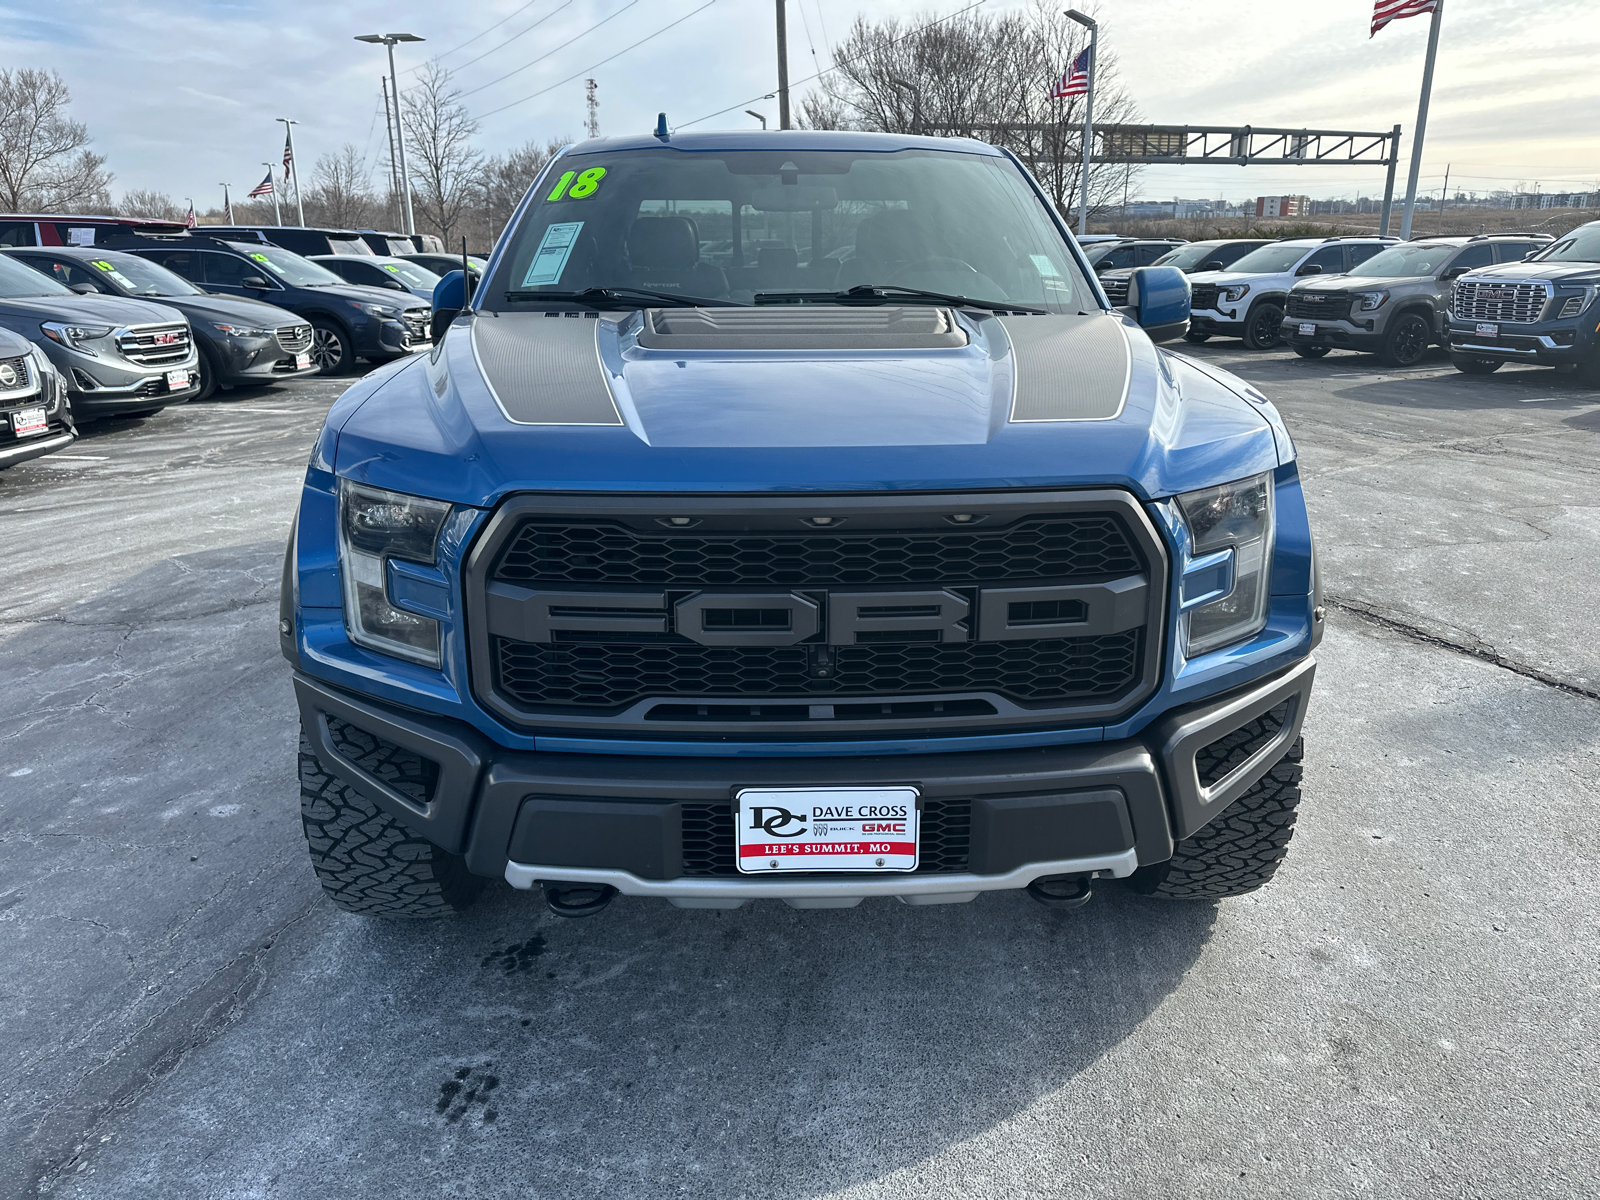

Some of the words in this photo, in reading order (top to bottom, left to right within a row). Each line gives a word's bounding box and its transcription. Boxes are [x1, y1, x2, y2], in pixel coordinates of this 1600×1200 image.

[547, 167, 607, 201] 18
[91, 260, 115, 271] 19
[1303, 295, 1325, 303] GMC
[1478, 290, 1513, 299] GMC
[154, 333, 179, 345] GMC
[487, 574, 1147, 647] FORD
[813, 806, 854, 818] DAVE
[858, 805, 907, 817] CROSS
[862, 823, 906, 832] GMC
[765, 845, 800, 854] LEE'S
[804, 844, 864, 854] SUMMIT,
[869, 843, 891, 852] MO
